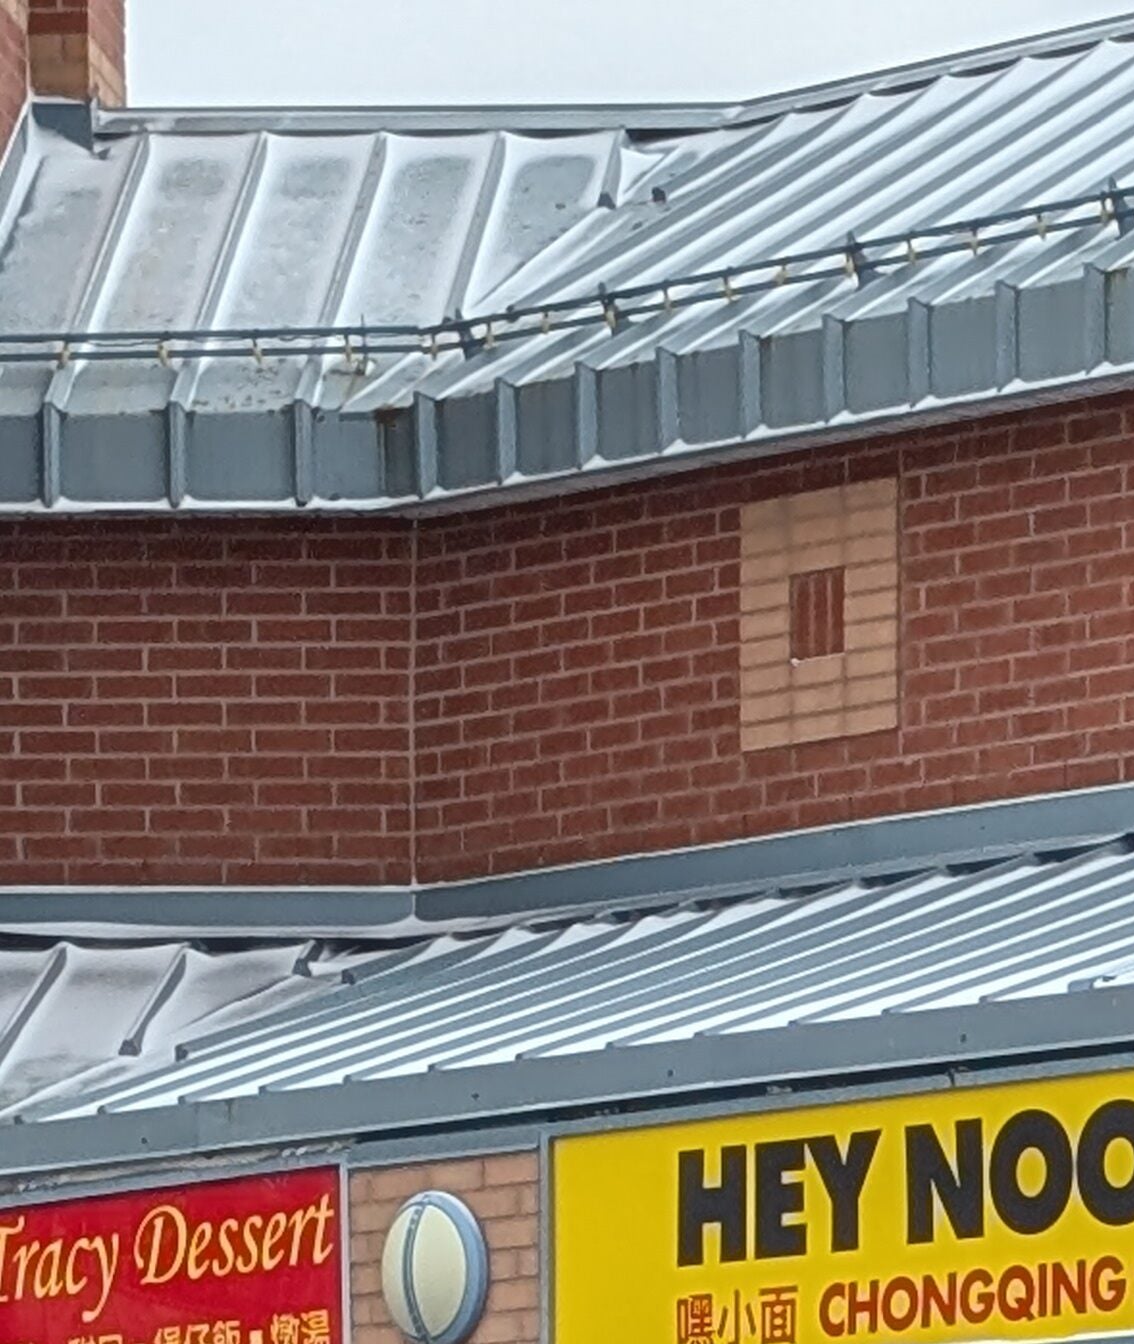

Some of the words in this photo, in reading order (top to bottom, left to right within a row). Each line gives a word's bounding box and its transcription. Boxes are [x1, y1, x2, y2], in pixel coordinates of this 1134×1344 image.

[134, 1193, 335, 1285] Dessert
[677, 1129, 882, 1267] HEY
[819, 1255, 1126, 1337] CHONGQING
